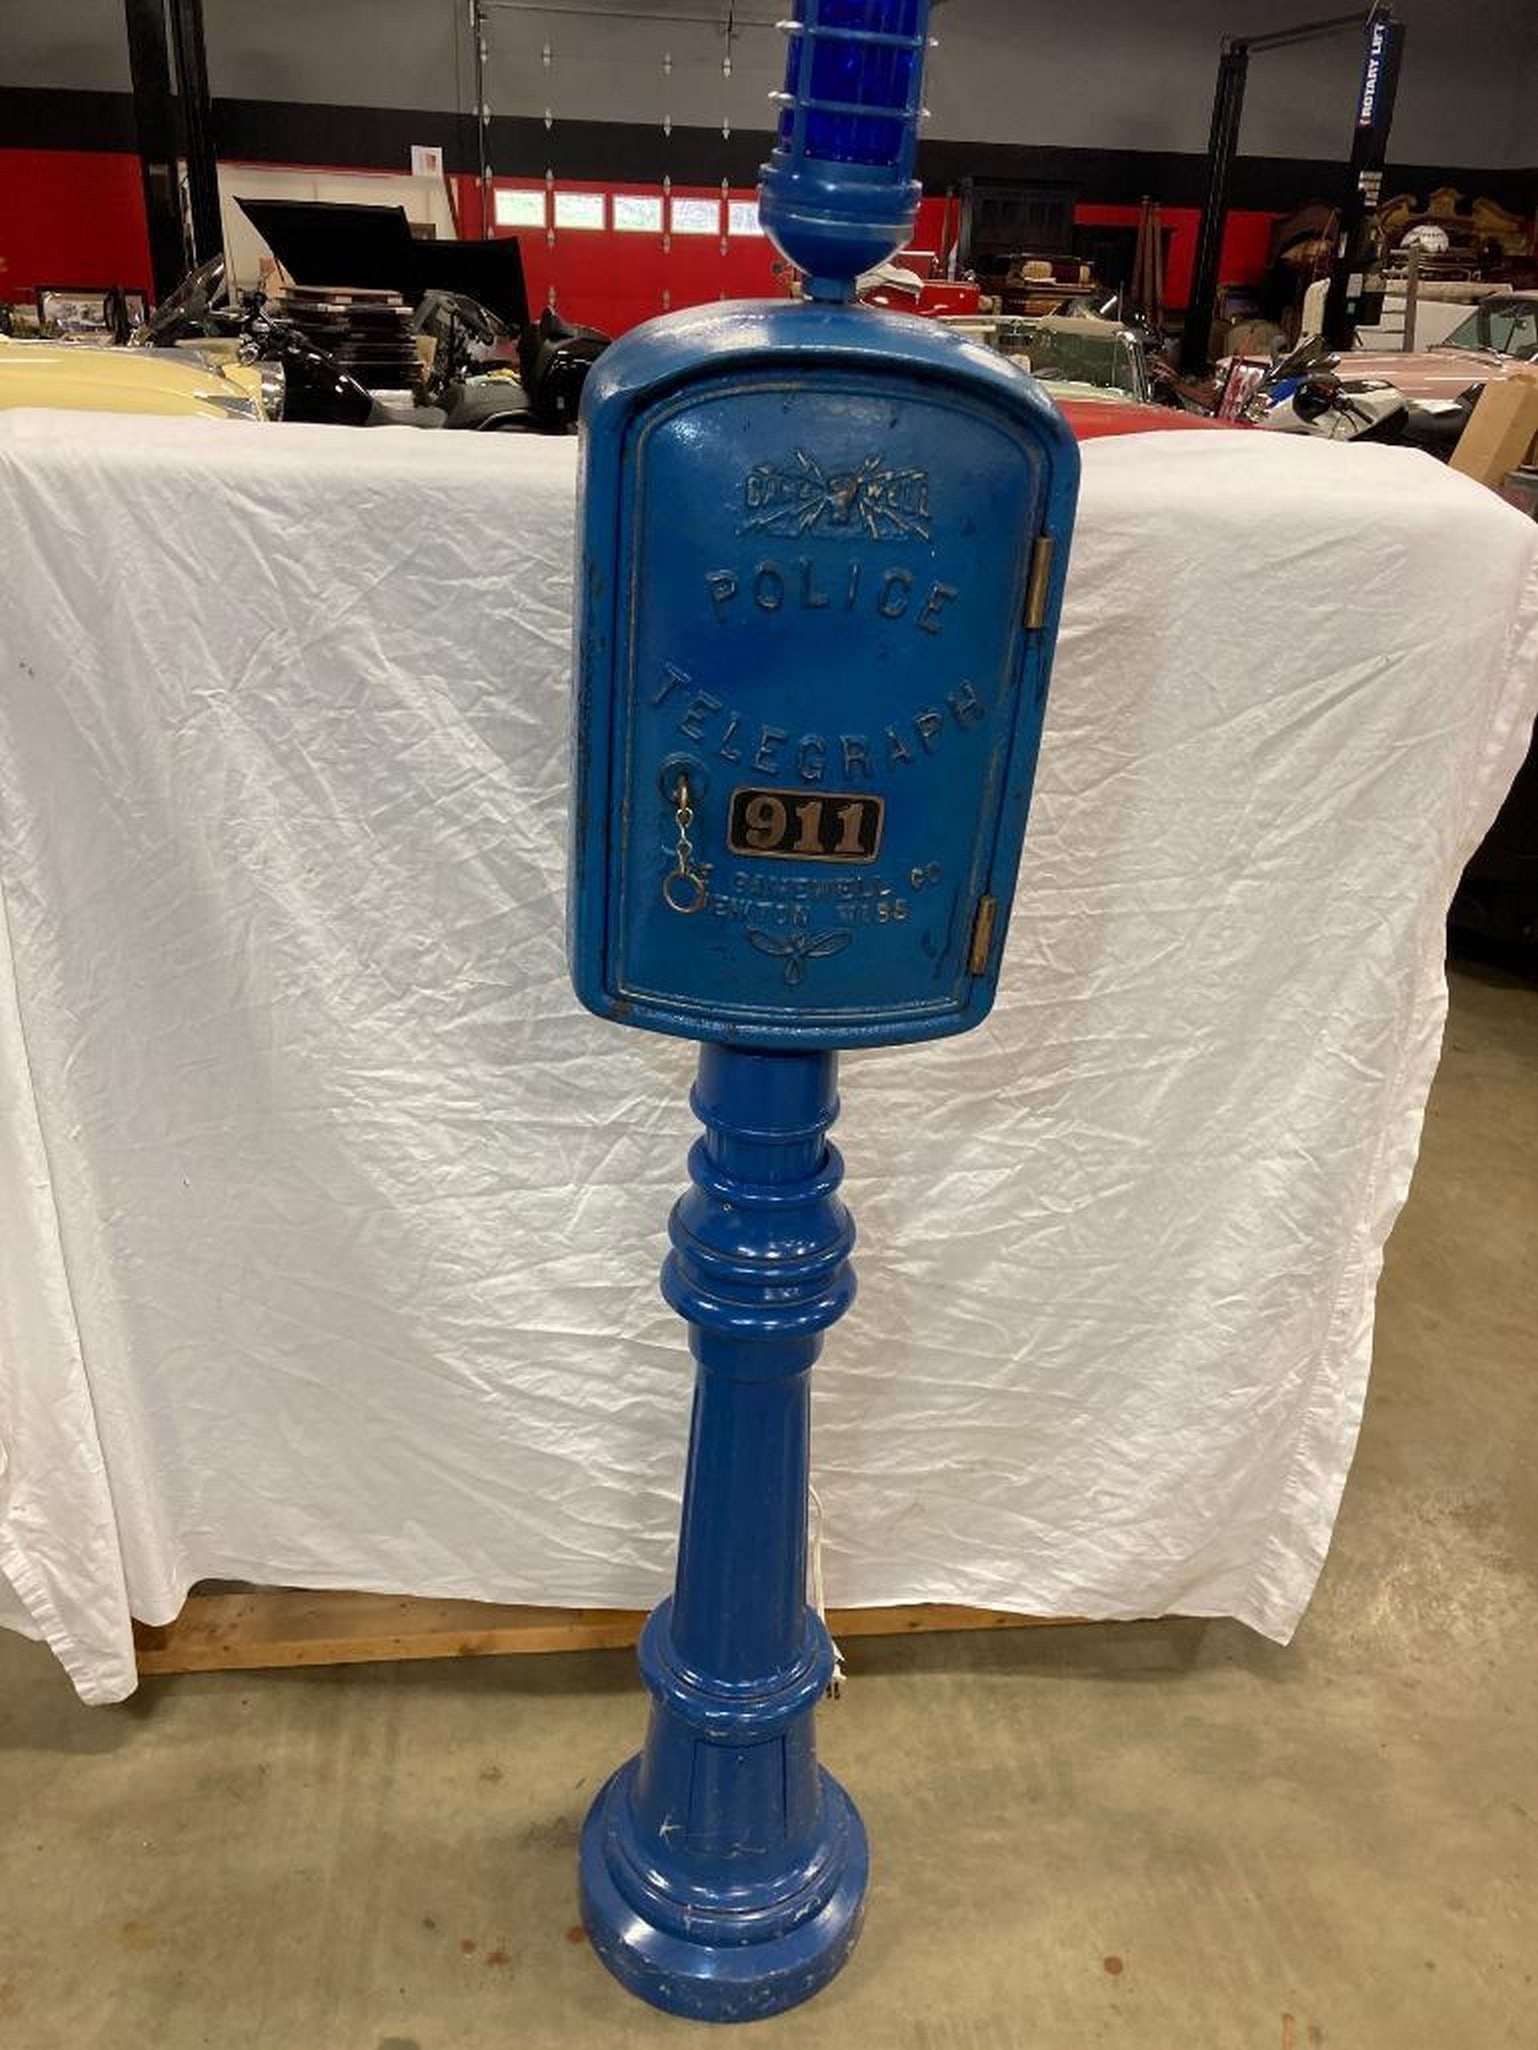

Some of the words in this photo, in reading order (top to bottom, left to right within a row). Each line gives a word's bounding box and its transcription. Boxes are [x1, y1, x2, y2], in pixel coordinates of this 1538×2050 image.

[1362, 58, 1379, 117] ROTARY
[1371, 23, 1385, 55] LIFT
[705, 556, 959, 635] POLICE
[652, 660, 985, 784] TELEGRAPH
[744, 796, 866, 853] 911
